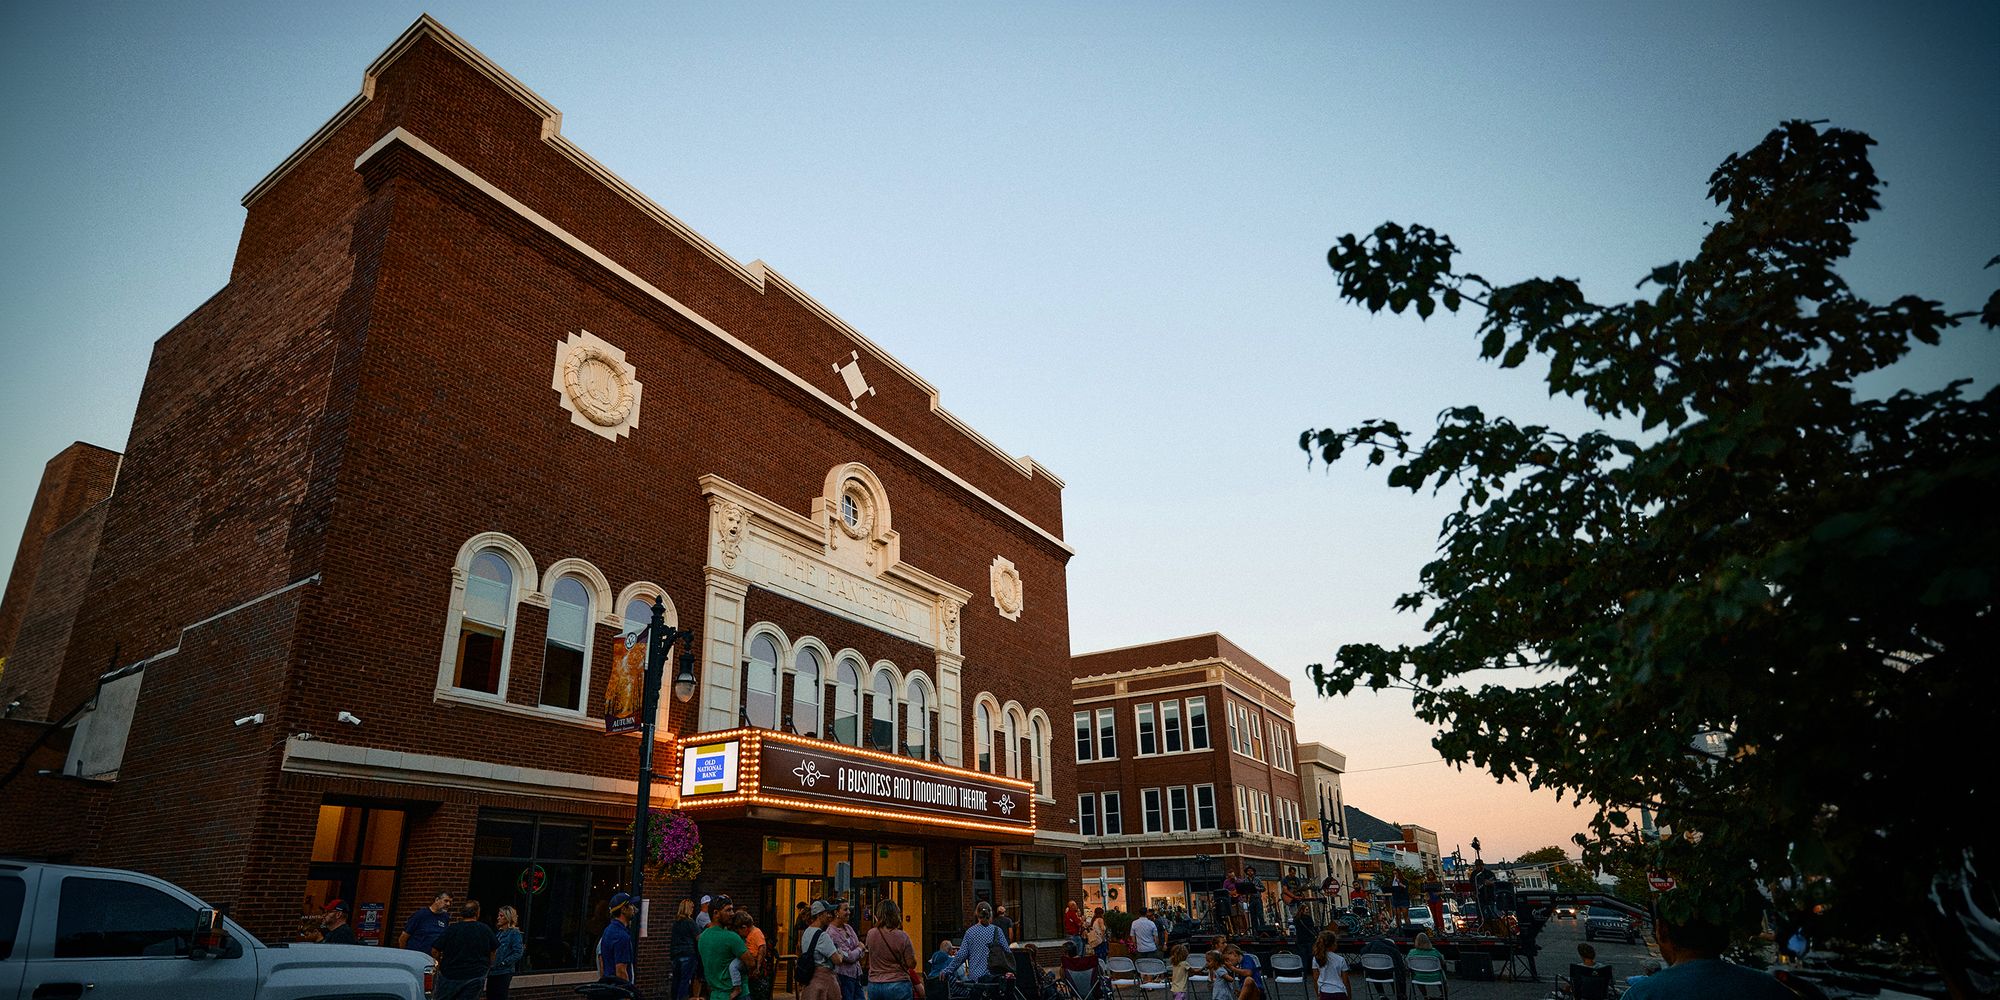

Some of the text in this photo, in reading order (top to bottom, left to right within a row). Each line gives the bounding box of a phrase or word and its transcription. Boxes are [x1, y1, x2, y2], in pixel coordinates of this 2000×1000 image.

[782, 553, 909, 621] THE PANTHEON
[697, 765, 723, 773] NATIONAL
[838, 767, 988, 811] A BUSINESS AND INNOVATION THEATRE
